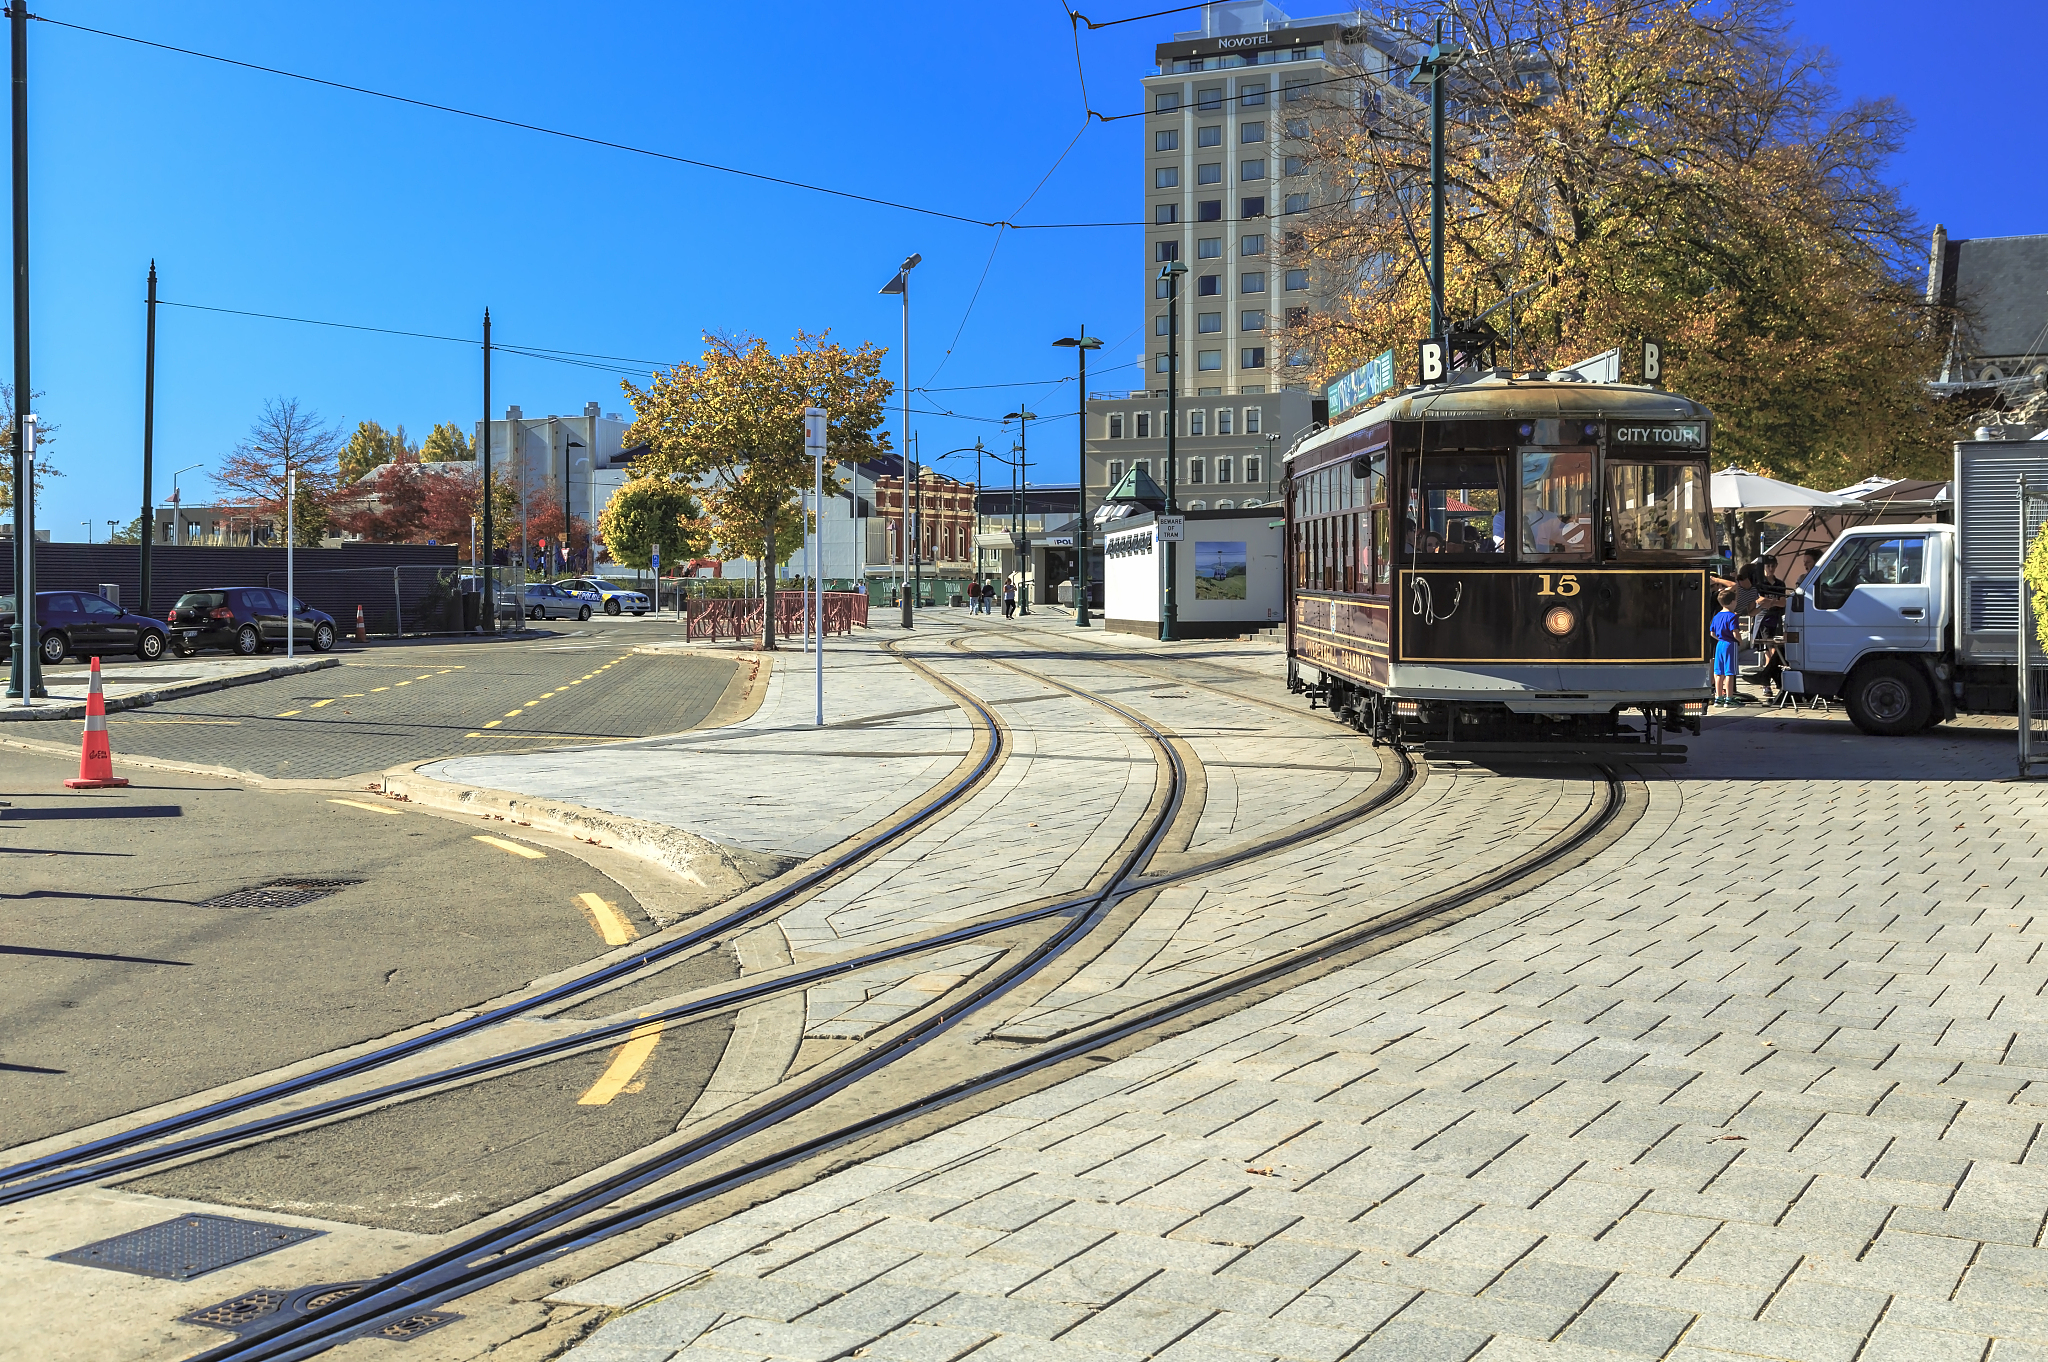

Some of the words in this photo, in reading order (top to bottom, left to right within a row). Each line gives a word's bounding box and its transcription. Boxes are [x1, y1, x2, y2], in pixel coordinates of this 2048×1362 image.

[1218, 34, 1272, 49] NOVOTEL
[1422, 343, 1442, 381] B
[1645, 342, 1660, 380] B
[1617, 428, 1650, 442] CITY
[1652, 428, 1693, 442] TOUR
[1537, 574, 1580, 597] 15
